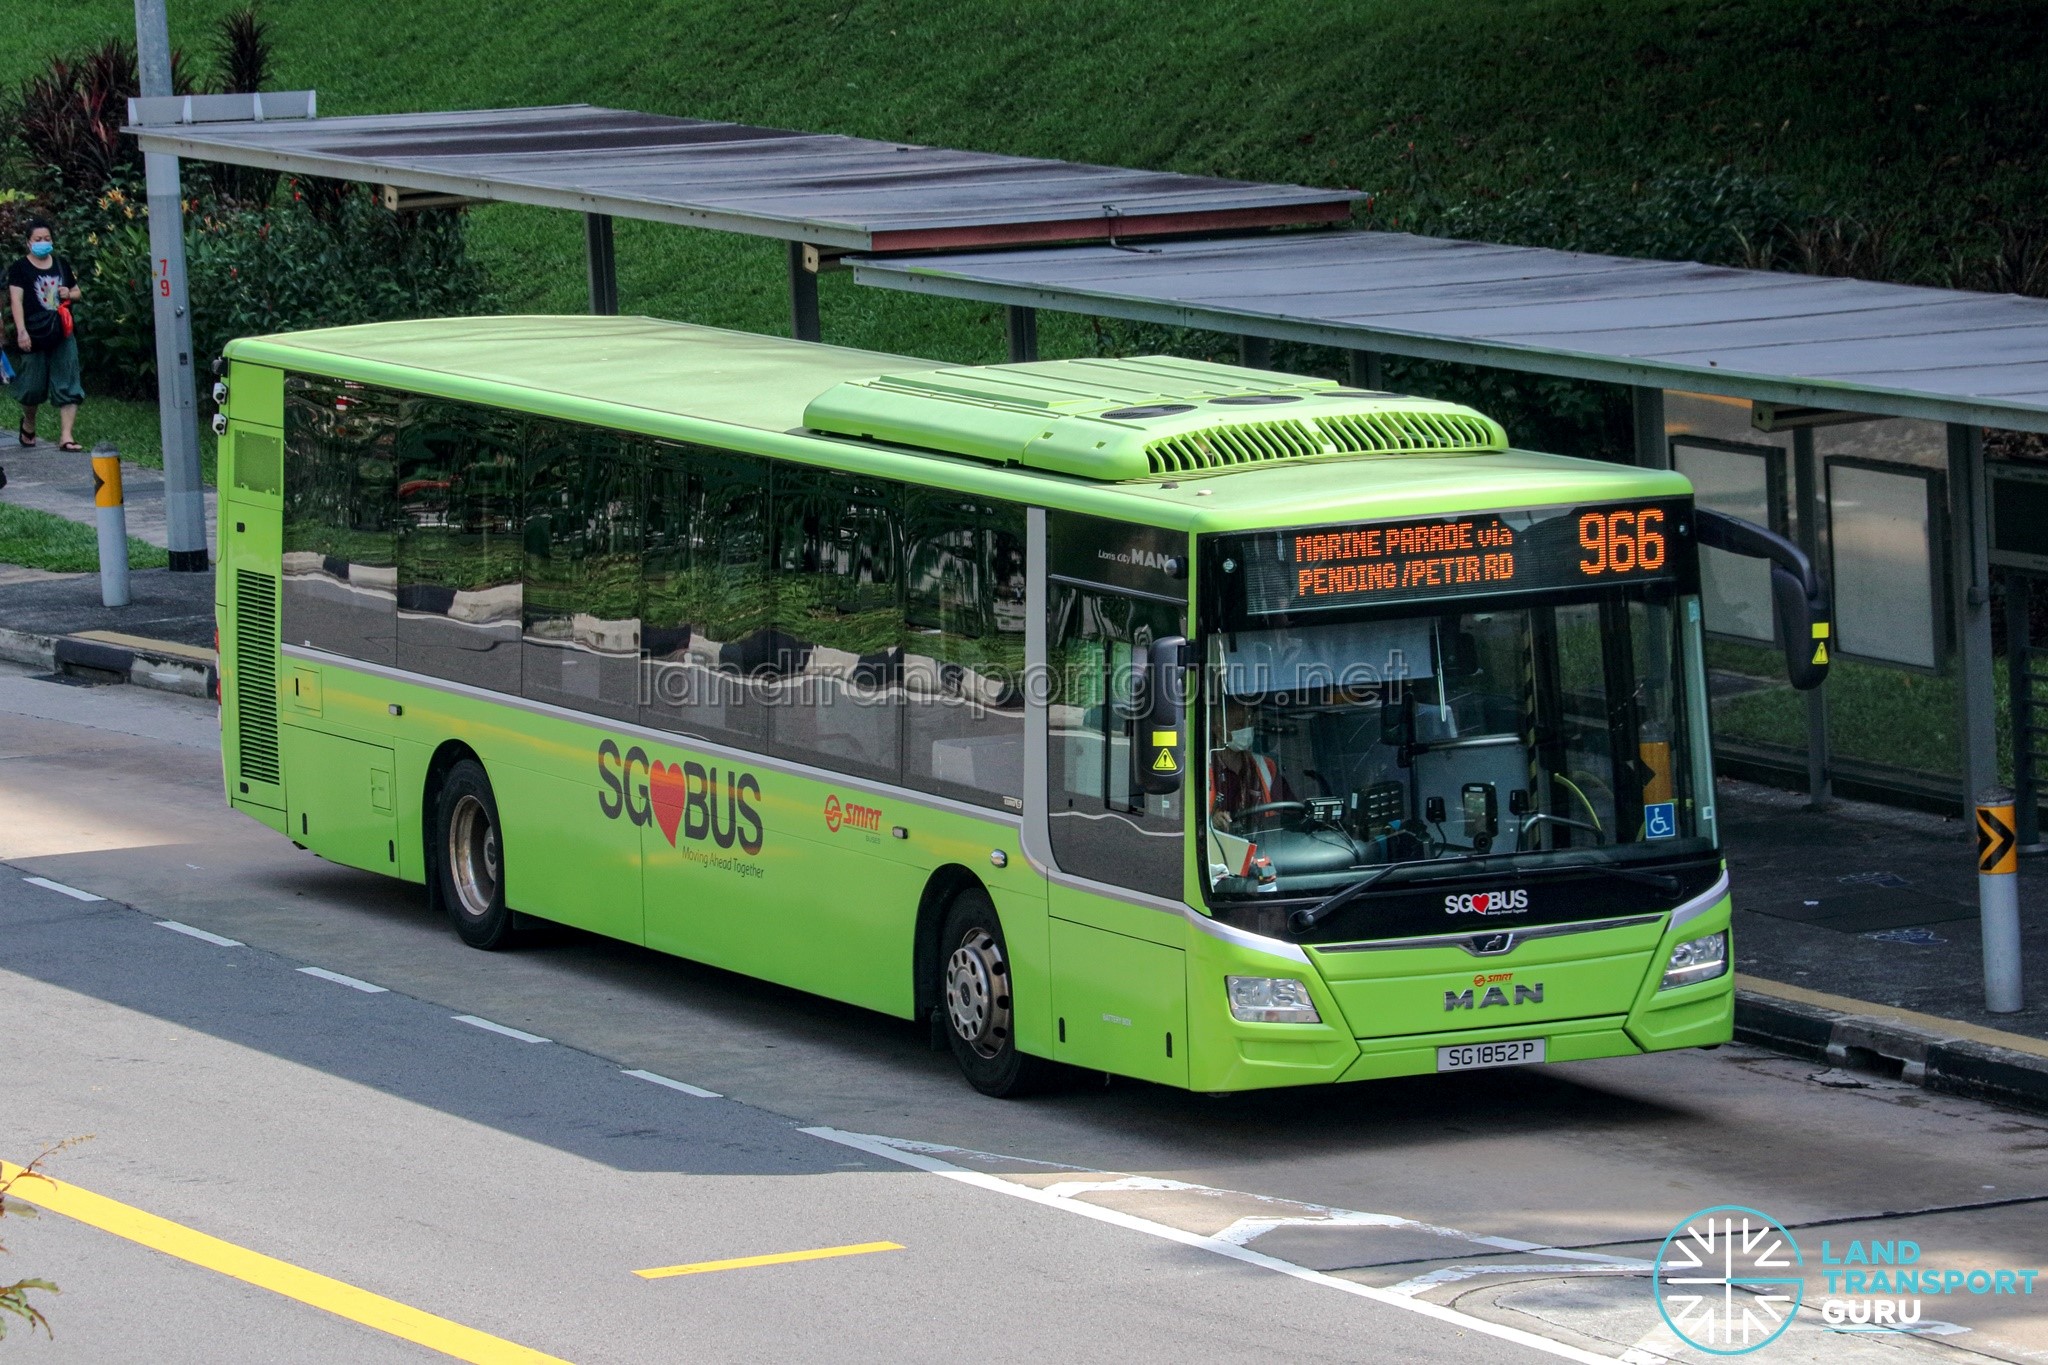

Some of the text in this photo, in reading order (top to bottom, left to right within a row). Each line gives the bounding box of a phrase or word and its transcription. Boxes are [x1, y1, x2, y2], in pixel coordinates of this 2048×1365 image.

[1295, 521, 1513, 562] MARINE PARADE via
[1578, 508, 1665, 575] 966
[1131, 548, 1169, 570] MAN
[1298, 563, 1397, 596] PENDING
[1485, 553, 1514, 579] RD
[844, 802, 882, 831] SMRT
[682, 846, 764, 878] Moving Ahead Together
[1487, 973, 1513, 982] SMRT
[1444, 983, 1544, 1011] MAN
